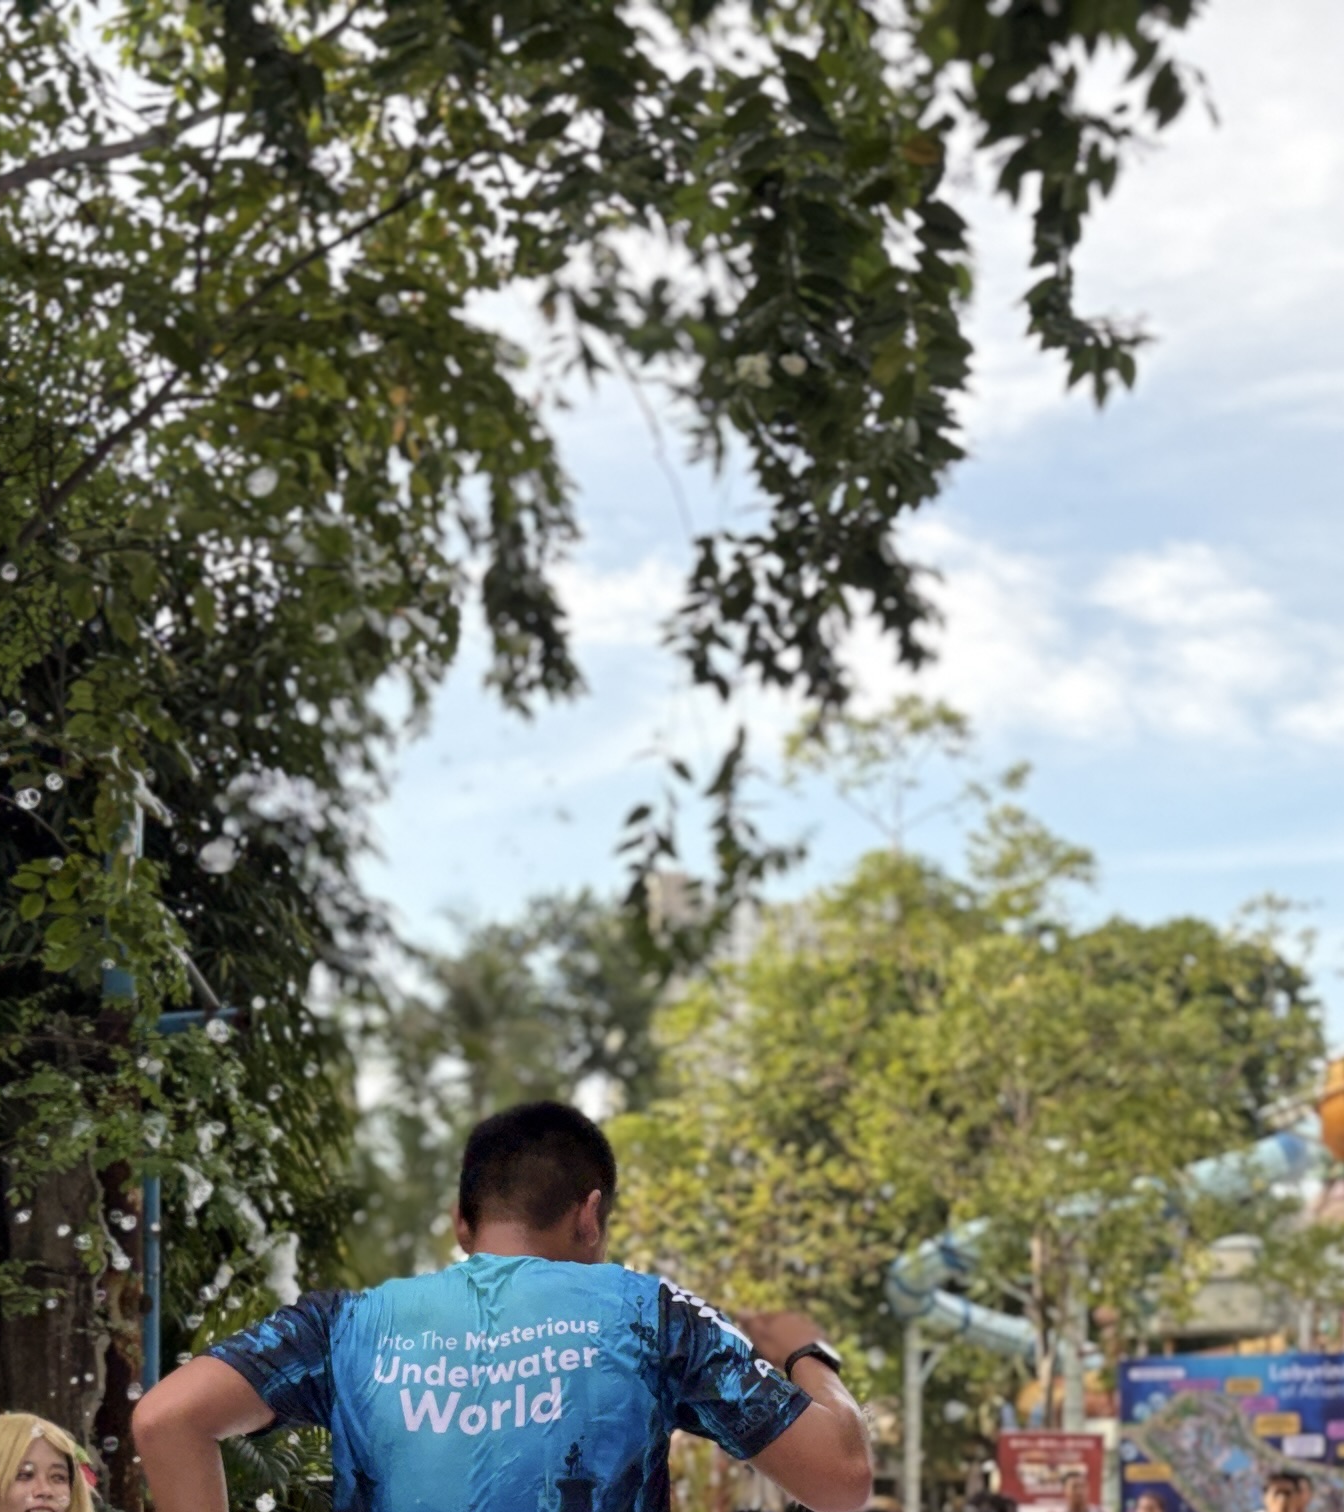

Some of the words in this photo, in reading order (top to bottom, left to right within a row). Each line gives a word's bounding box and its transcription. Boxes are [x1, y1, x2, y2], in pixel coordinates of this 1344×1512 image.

[377, 1331, 415, 1351] Into
[421, 1330, 458, 1350] The
[465, 1317, 600, 1354] Mysterious
[373, 1345, 601, 1388] Underwater
[399, 1376, 563, 1436] World
